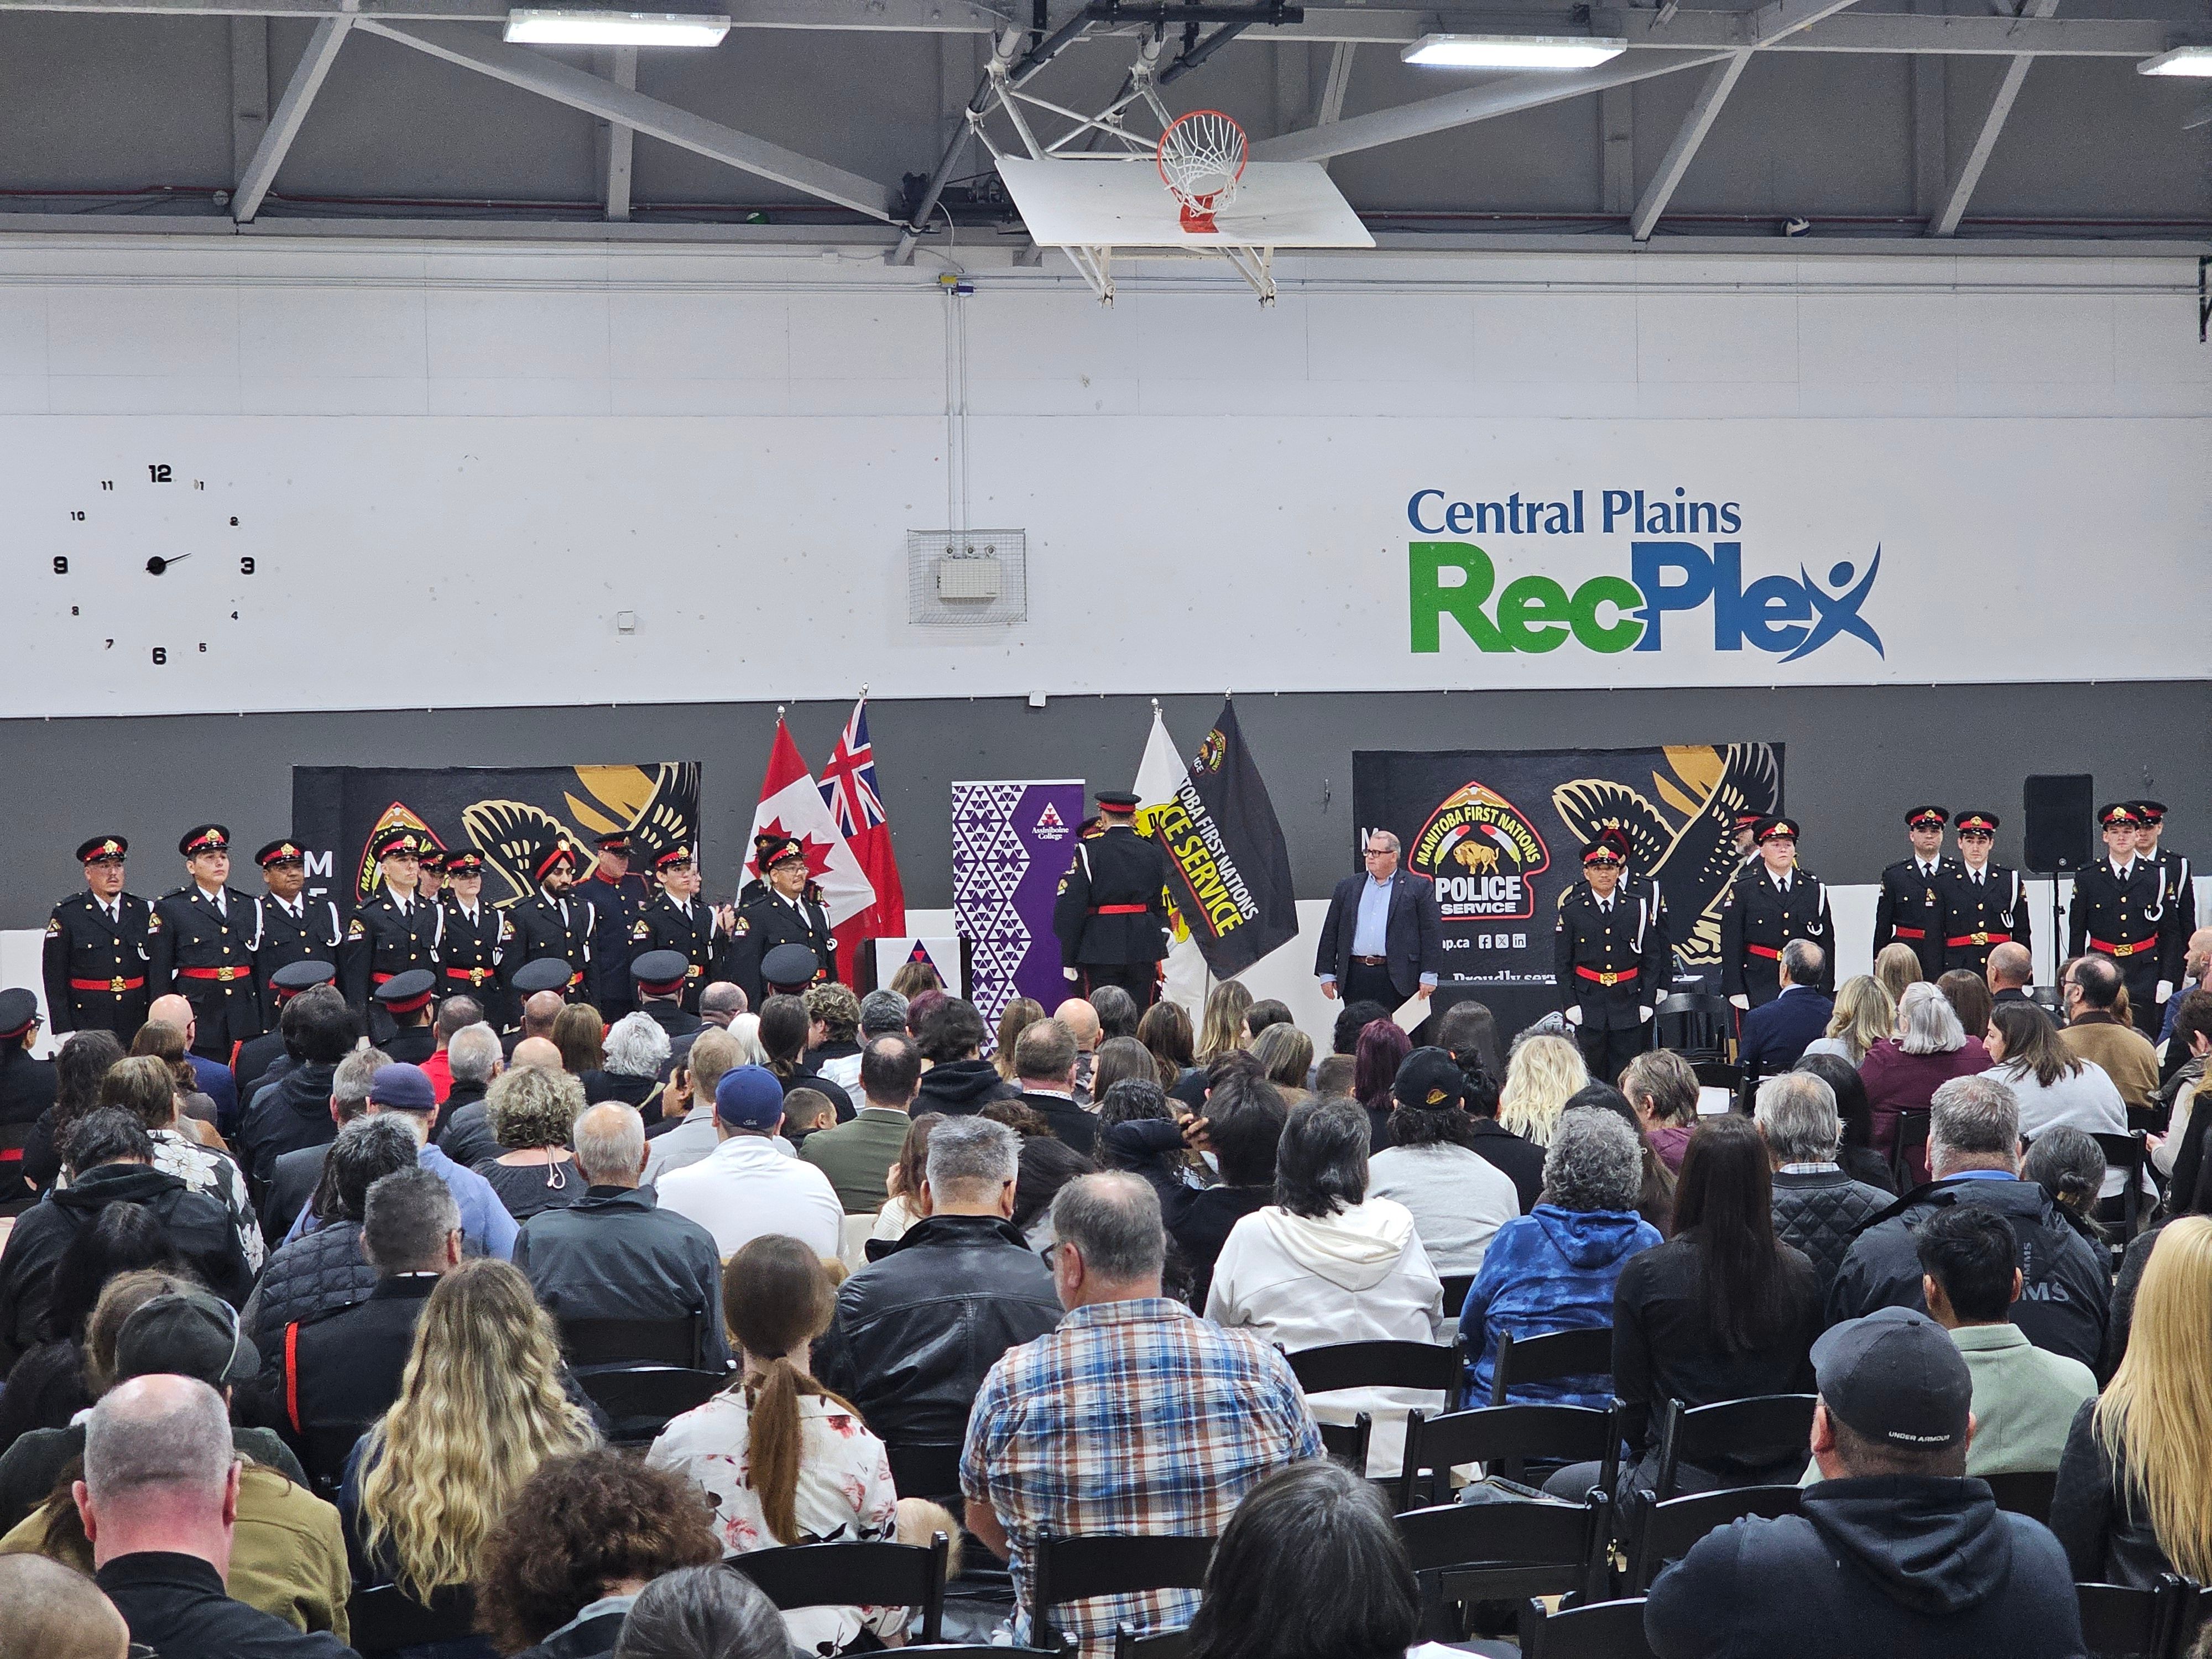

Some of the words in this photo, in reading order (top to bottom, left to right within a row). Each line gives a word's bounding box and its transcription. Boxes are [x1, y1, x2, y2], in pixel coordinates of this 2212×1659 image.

[149, 465, 171, 482] 12
[101, 481, 113, 491] 11
[200, 482, 204, 490] 1
[71, 511, 85, 521] 10
[1407, 489, 1584, 534] Central
[1602, 487, 1743, 534] Plains
[230, 517, 239, 526] 2
[54, 556, 68, 574] 9
[241, 557, 254, 575] 3
[72, 606, 79, 615] 8
[1408, 541, 1885, 664] RecPlex
[231, 611, 238, 620] 4
[106, 639, 113, 649] 7
[200, 643, 206, 652] 5
[153, 648, 166, 665] 6
[1416, 809, 1464, 866] MANITOBA
[1464, 806, 1499, 823] FIRST
[1498, 813, 1541, 863] NATIONS
[304, 851, 332, 878] M
[1195, 816, 1226, 858] FIRST
[1217, 855, 1259, 920] NATIONS
[1173, 835, 1244, 937] SERVICE
[1435, 875, 1521, 902] POLICE
[1441, 902, 1516, 915] SERVICE
[1888, 1431, 1917, 1441] UNDER
